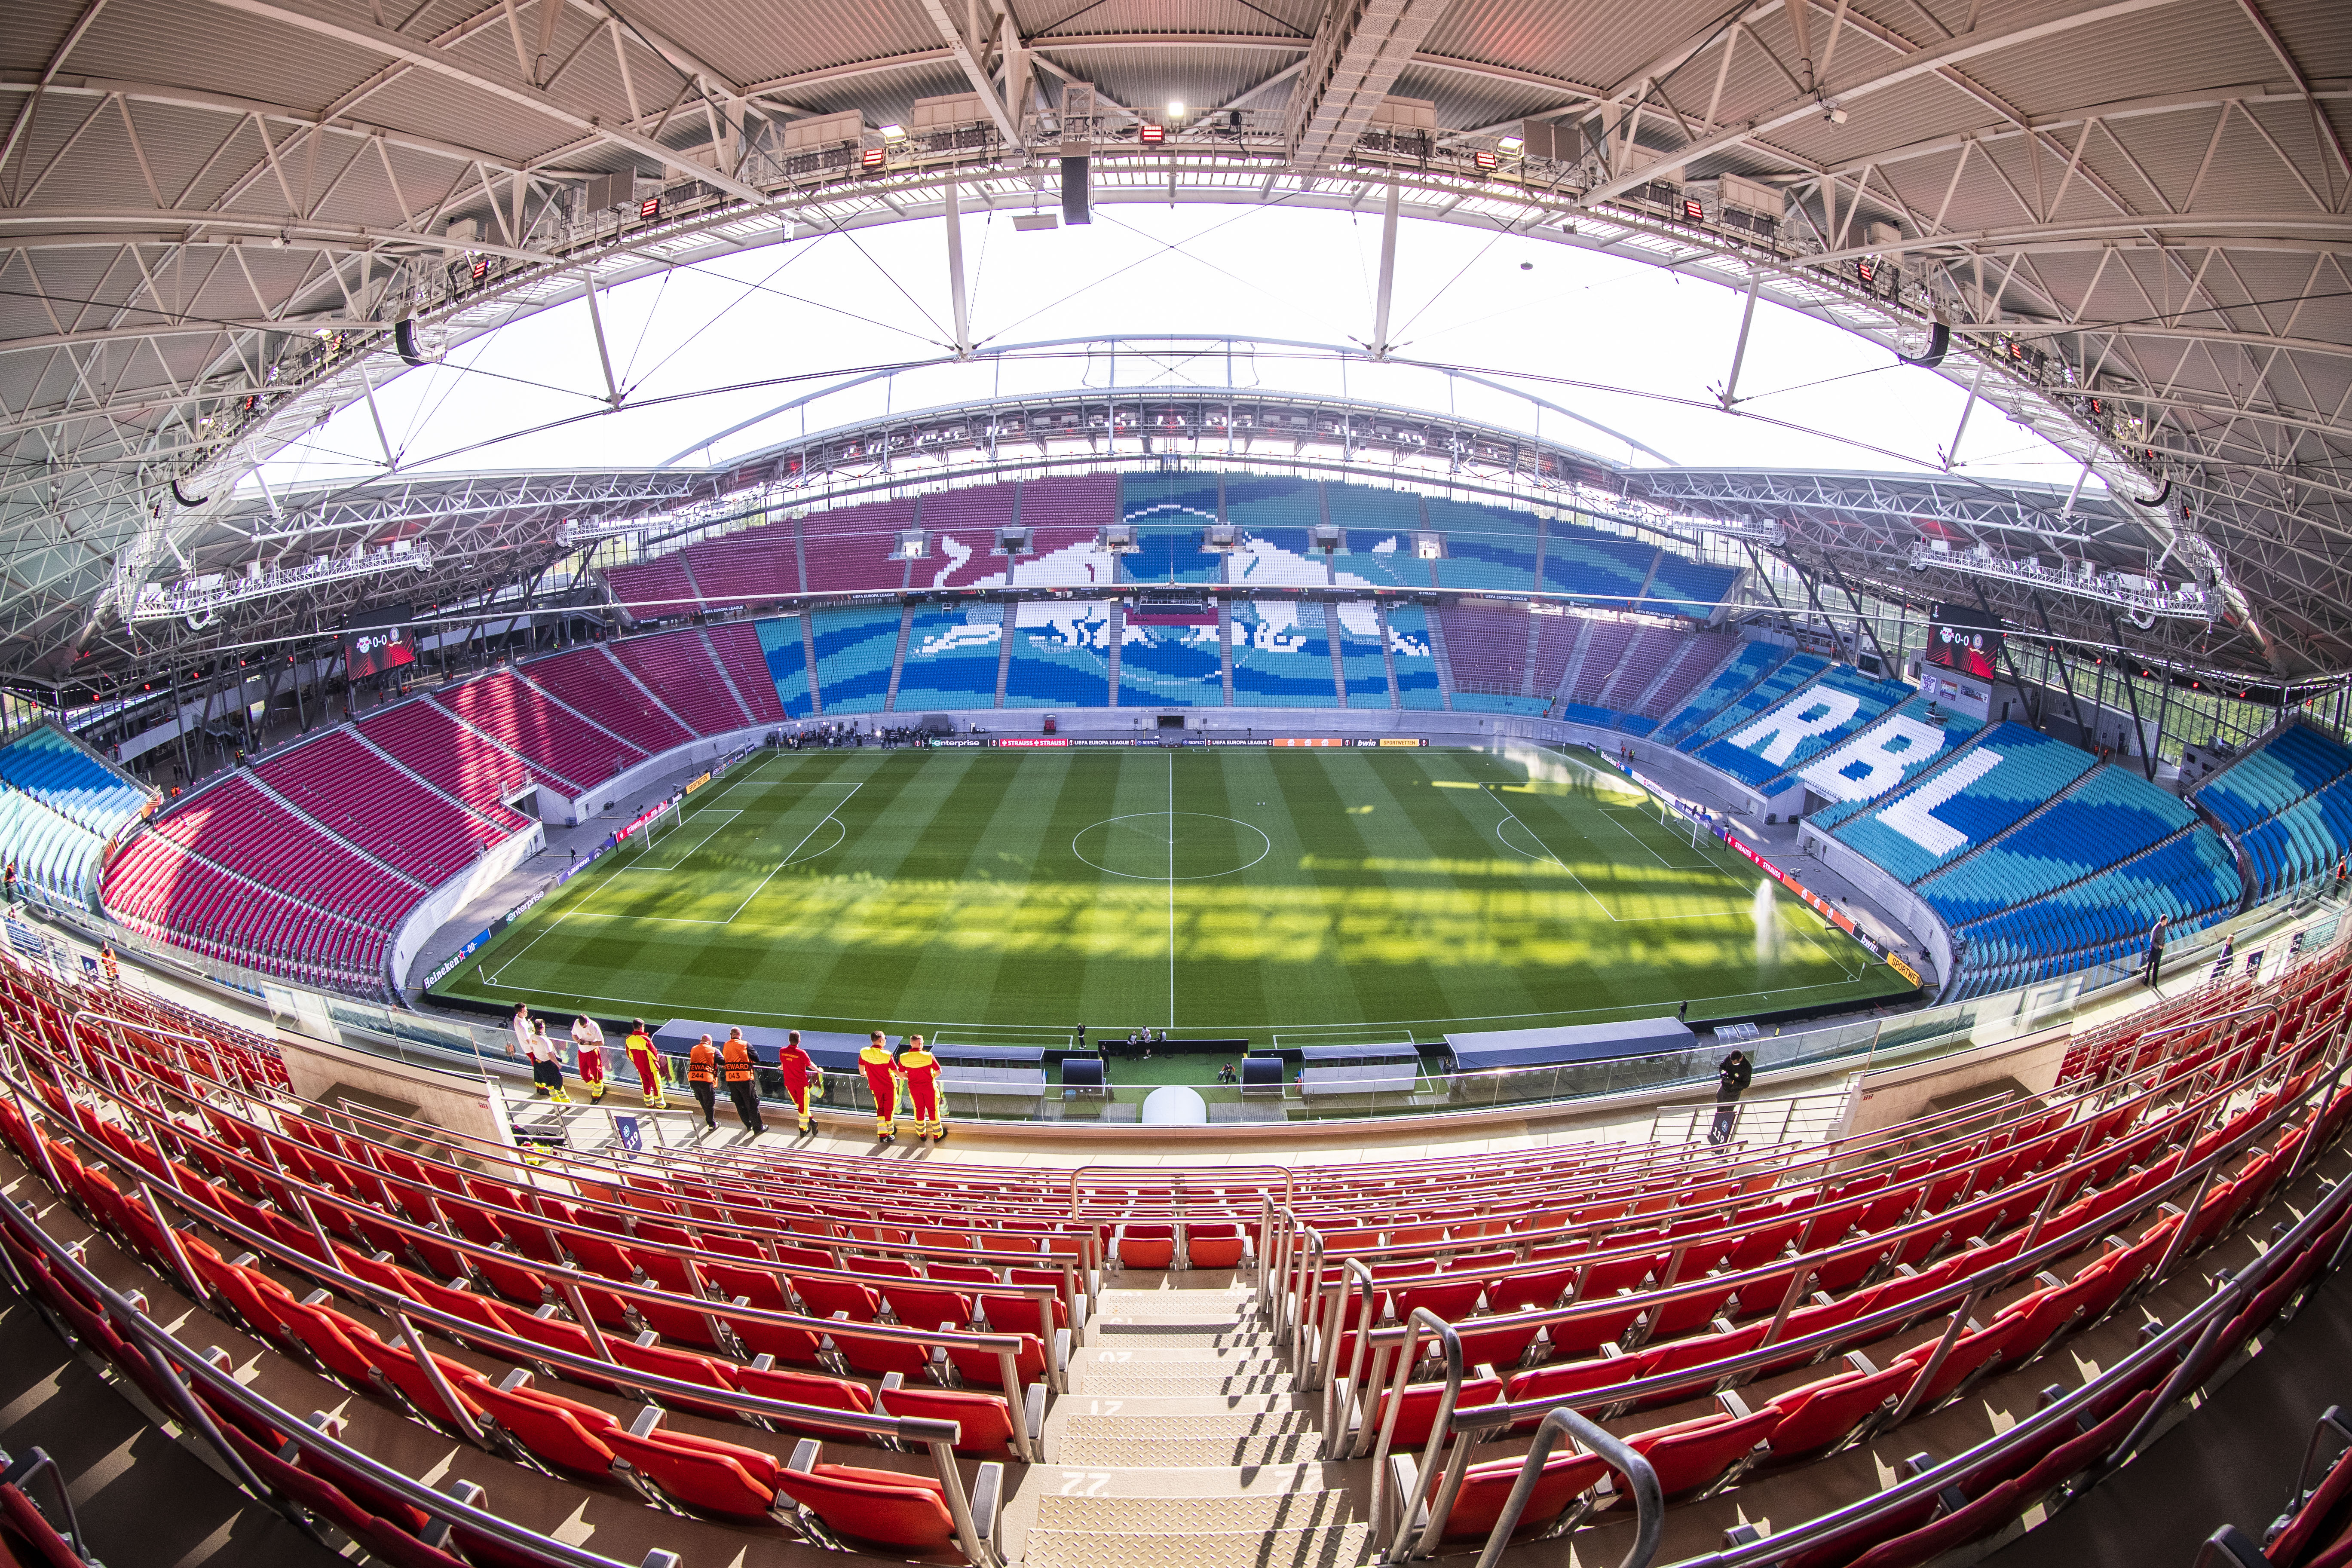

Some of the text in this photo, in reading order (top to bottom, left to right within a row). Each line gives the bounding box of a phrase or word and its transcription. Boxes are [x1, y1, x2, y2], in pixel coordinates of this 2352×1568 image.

[373, 634, 387, 648] 0-0
[1955, 633, 1969, 646] 0-0
[933, 739, 980, 747] enterprise
[1728, 684, 2004, 858] RBL
[689, 775, 707, 791] SPORTWETTEN
[1647, 781, 1662, 796] Swissquote
[672, 792, 682, 804] bwin
[626, 820, 642, 834] STRAUSS
[1735, 842, 1781, 879] STRAUSS STRAUSS
[506, 890, 544, 922] enterprise
[1861, 934, 1878, 952] bwin
[423, 956, 460, 989] Heineken
[627, 1131, 638, 1149] 119
[1712, 1126, 1724, 1143] 119
